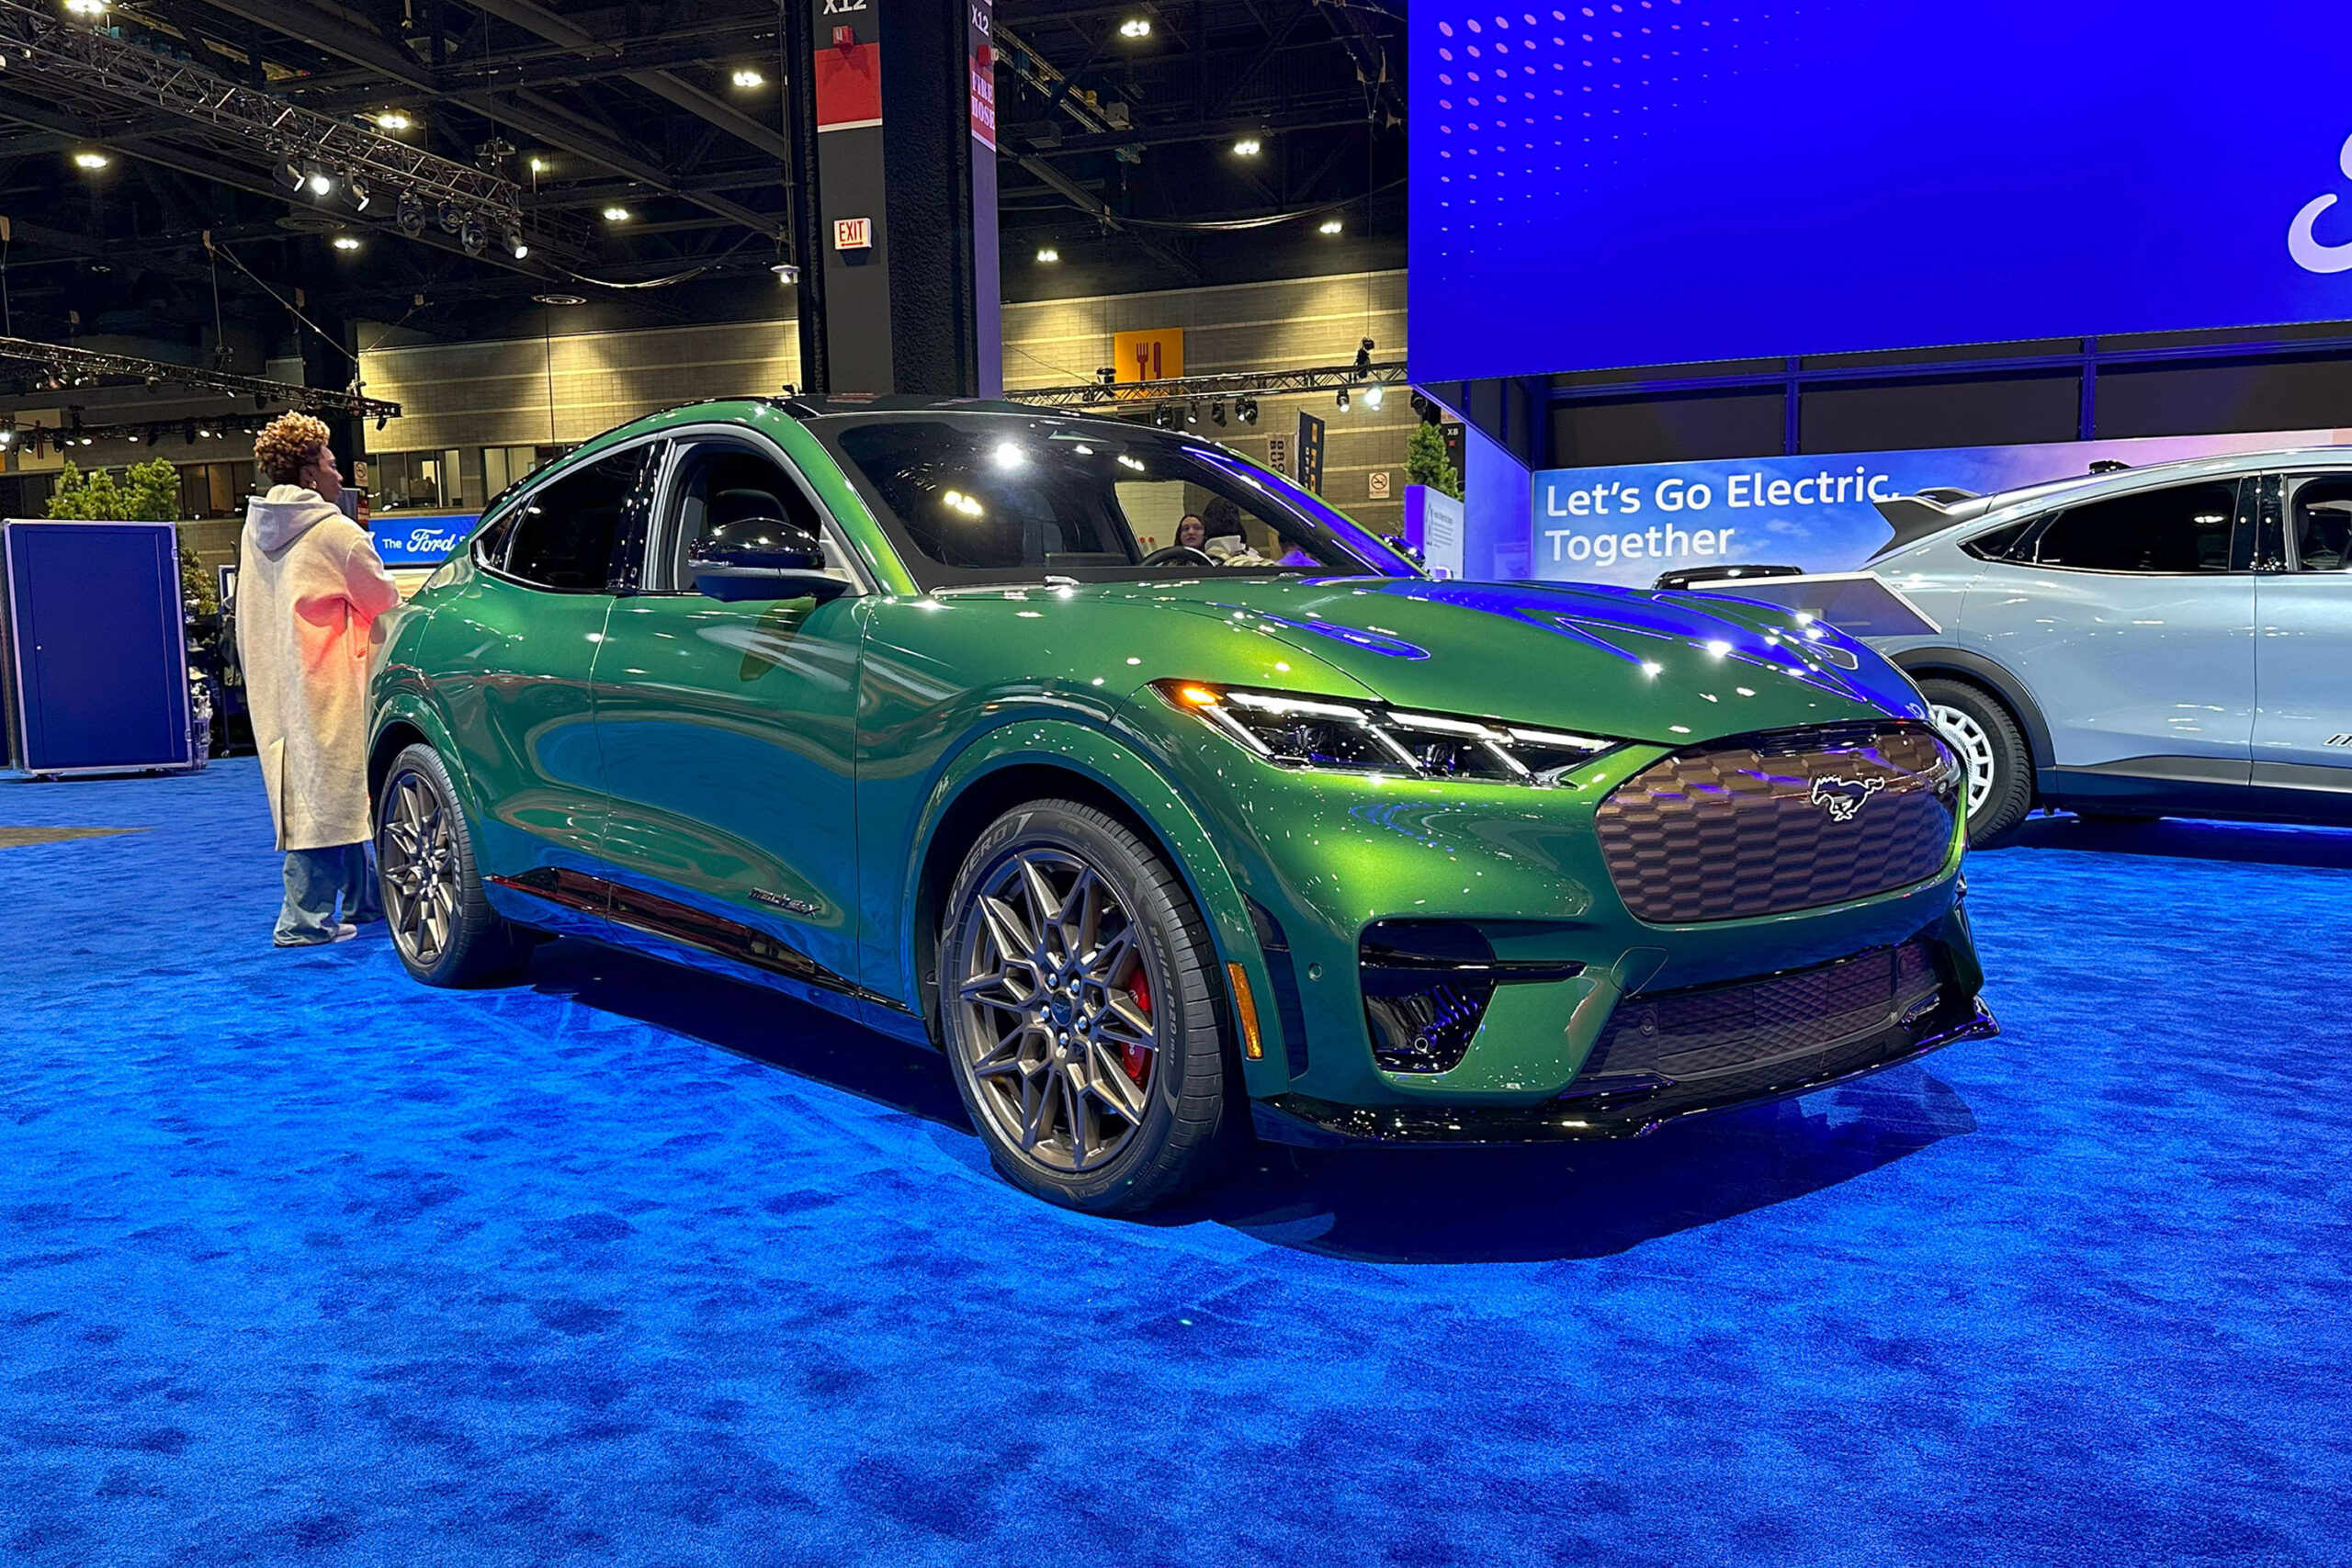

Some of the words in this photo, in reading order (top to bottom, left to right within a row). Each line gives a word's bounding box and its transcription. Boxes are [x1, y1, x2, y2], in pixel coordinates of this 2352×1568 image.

[971, 5, 989, 37] X12
[971, 71, 993, 104] FIRE
[971, 96, 995, 130] HOSE
[839, 220, 864, 242] EXIT
[1655, 478, 1711, 511] Go
[382, 538, 402, 548] The
[406, 528, 456, 552] Ford
[1544, 523, 1735, 567] Together
